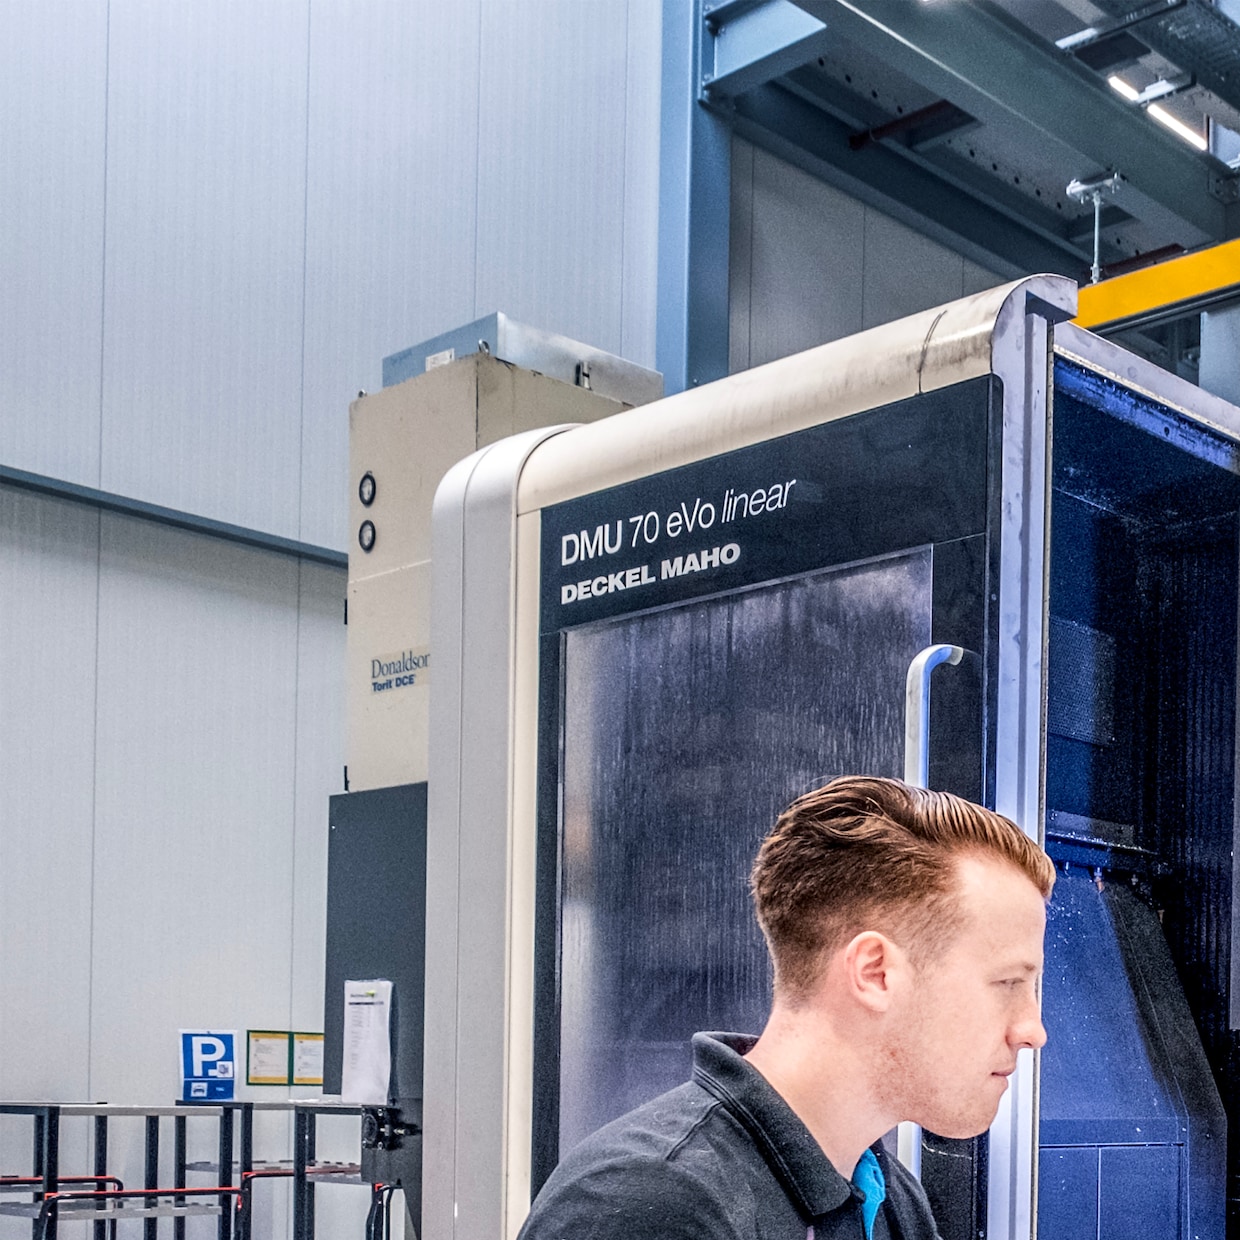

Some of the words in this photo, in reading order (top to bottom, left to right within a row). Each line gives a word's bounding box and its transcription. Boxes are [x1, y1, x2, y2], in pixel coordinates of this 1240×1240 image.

[561, 520, 622, 566] DMU
[629, 511, 660, 547] 70
[666, 498, 716, 538] eVo
[721, 479, 797, 523] linear
[561, 565, 656, 605] DECKEL
[661, 542, 741, 580] MAHO
[395, 673, 416, 687] DCE
[191, 1036, 227, 1077] P
